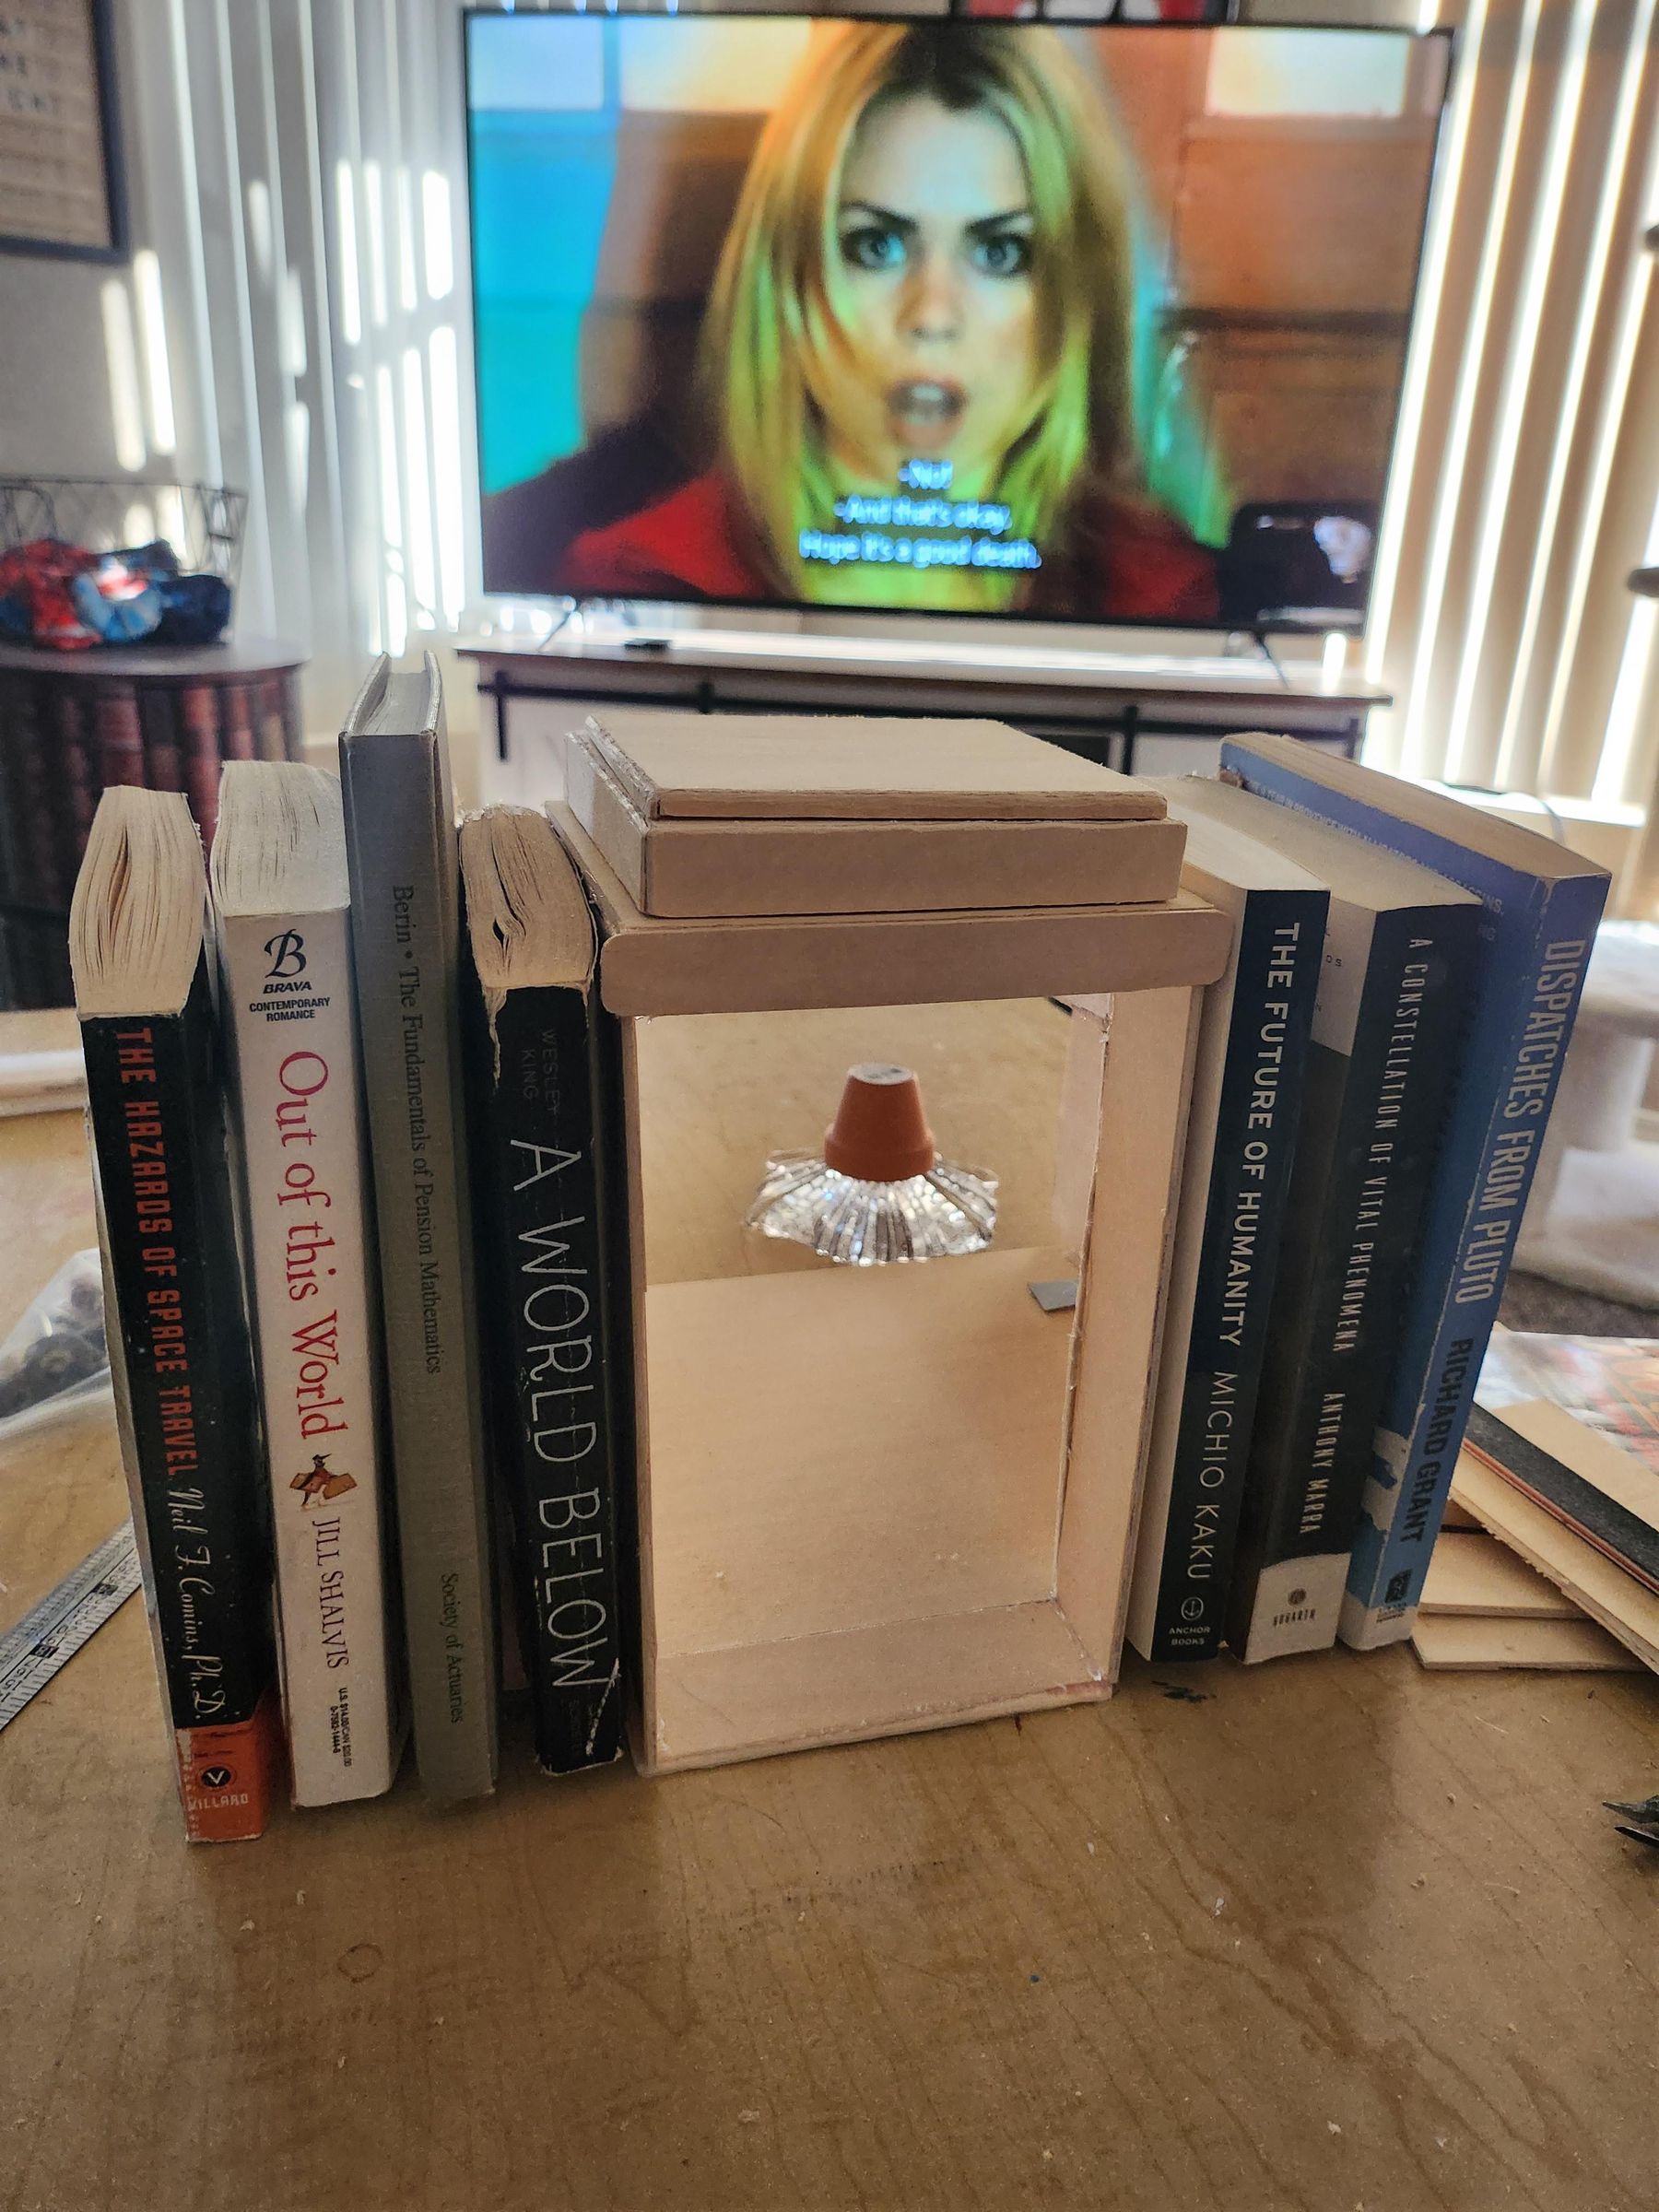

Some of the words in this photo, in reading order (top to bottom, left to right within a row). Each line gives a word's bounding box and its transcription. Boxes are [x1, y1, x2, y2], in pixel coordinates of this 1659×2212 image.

[394, 886, 417, 944] Berin
[1408, 936, 1433, 949] A
[263, 981, 312, 994] BRAVA
[264, 928, 307, 979] B
[399, 966, 420, 1007] The
[1266, 922, 1300, 989] THE
[249, 997, 331, 1013] CONTEMPORARY
[266, 1009, 315, 1022] ROMANCE
[1502, 938, 1586, 1120] DISPATCHES
[116, 1027, 156, 1084] THE
[522, 1048, 539, 1100] KING
[541, 1029, 561, 1113] WESLEY
[1247, 1000, 1288, 1130] FUTURE
[1374, 962, 1429, 1130] CONSTELLATION
[276, 1051, 329, 1147] Out
[403, 1014, 431, 1151] Fundamentals
[124, 1101, 173, 1234] HAZARDS
[277, 1162, 331, 1207] of
[413, 1159, 433, 1179] of
[510, 1138, 582, 1192] A
[1241, 1140, 1269, 1181] OF
[1368, 1142, 1394, 1165] OF
[1478, 1128, 1536, 1212] FROM
[415, 1182, 435, 1255] Pension
[1354, 1175, 1387, 1231] VITAL
[142, 1245, 178, 1277] OF
[286, 1221, 336, 1302] this
[1219, 1191, 1262, 1347] HUMANITY
[1332, 1241, 1375, 1352] PHENOMENA
[1454, 1218, 1511, 1305] PLUTO
[147, 1289, 188, 1373] SPACE
[420, 1261, 444, 1374] Mathematics
[518, 1216, 597, 1462] WORLD
[291, 1309, 348, 1440] World
[1423, 1337, 1475, 1459] RICHARD
[159, 1385, 198, 1476] TRAVEL
[1199, 1371, 1239, 1489] MICHIO
[1312, 1392, 1346, 1469] ANTHONY
[169, 1488, 208, 1535] Neil
[1299, 1477, 1330, 1535] MARRA
[1399, 1460, 1442, 1544] GRANT
[312, 1516, 341, 1567] JILL
[1187, 1504, 1220, 1580] KAKU
[319, 1571, 349, 1669] SHALVIS
[440, 1572, 461, 1629] Society
[538, 1487, 611, 1688] BELOW
[445, 1635, 464, 1649] of
[1169, 1625, 1211, 1635] ANCHOR
[1171, 1637, 1205, 1646] BOOKS
[446, 1653, 466, 1724] Actuaries
[207, 1771, 225, 1784] V
